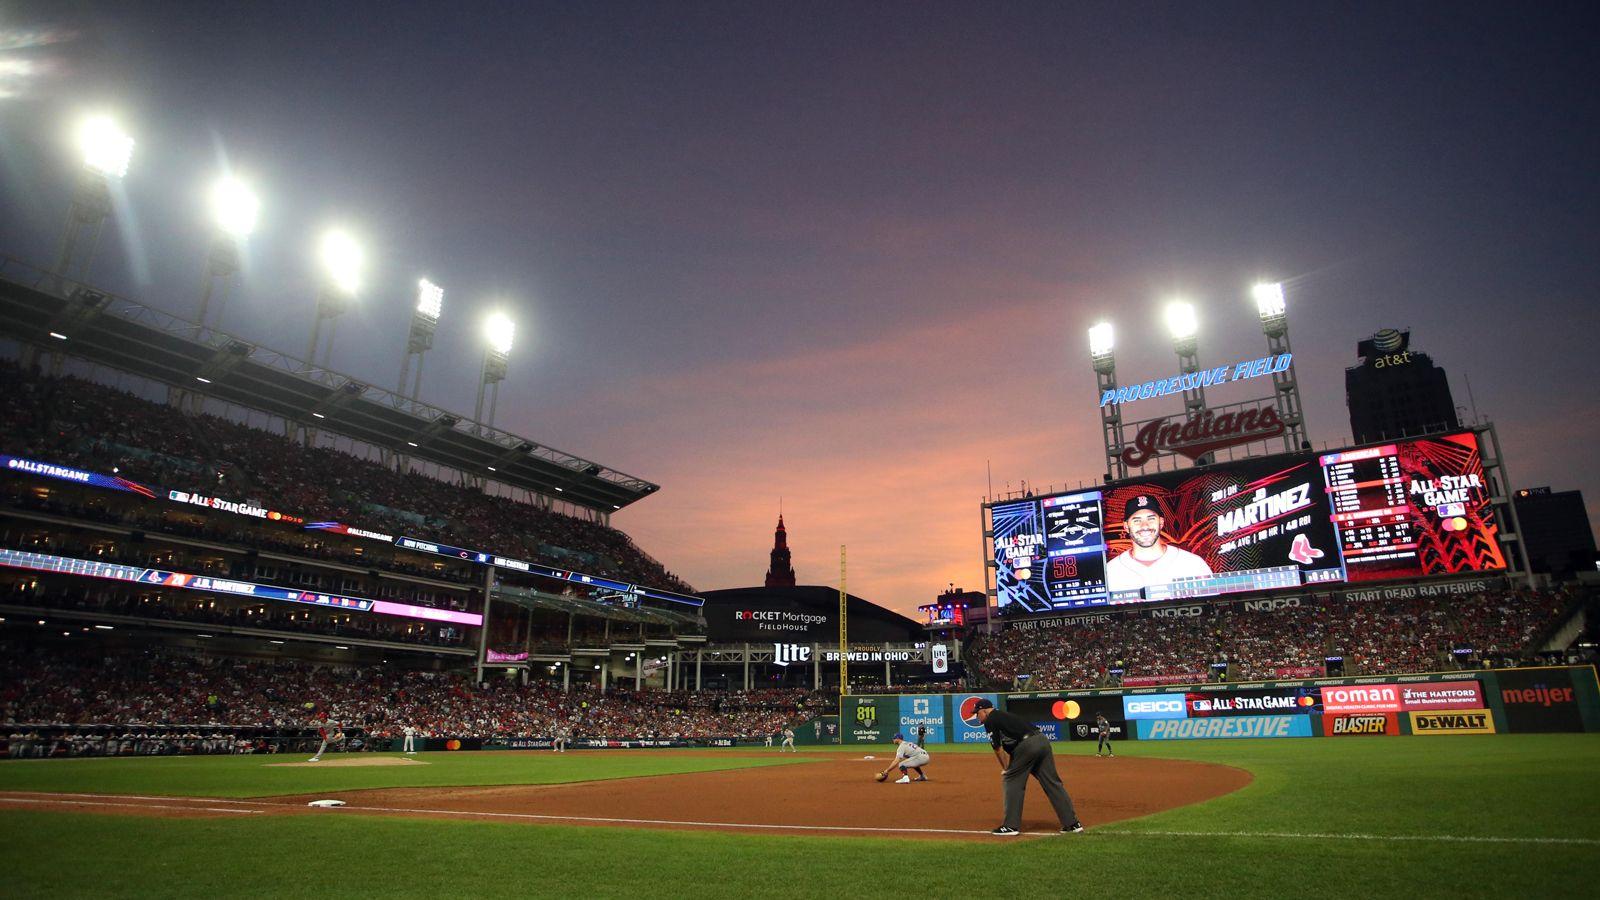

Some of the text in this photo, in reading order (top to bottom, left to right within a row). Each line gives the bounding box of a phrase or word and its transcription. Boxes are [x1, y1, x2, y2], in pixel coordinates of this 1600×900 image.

[1374, 350, 1411, 369] at&t
[1100, 353, 1292, 407] PROGRESSIVE FIELD
[1121, 405, 1285, 468] Indians
[1410, 474, 1482, 495] ALL STAR
[1424, 488, 1470, 506] GAME
[189, 493, 268, 519] ALL STAR GAME
[1217, 482, 1311, 537] MARTINEZ
[1268, 526, 1278, 536] HR
[1299, 515, 1311, 527] RBI
[996, 534, 1045, 549] ALL STAR
[1006, 546, 1035, 559] GAME
[1053, 556, 1078, 578] 58
[1345, 589, 1382, 602] START
[1385, 587, 1417, 600] DEAD
[1152, 607, 1202, 618] NOCO
[1245, 598, 1300, 612] NOCO
[735, 611, 827, 624] ROCKET Mortgage
[1012, 620, 1037, 631] START
[773, 643, 810, 666] Lite
[826, 652, 909, 661] BREWED IN OHIO
[1326, 688, 1395, 703] roman
[1429, 689, 1476, 698] HARTFORD
[1502, 684, 1573, 707] meijer
[1127, 700, 1183, 713] GEICO
[1212, 696, 1297, 710] ALL STAR GAME
[856, 707, 876, 720] 811
[900, 717, 943, 725] Cleveland
[909, 727, 935, 736] Clic
[1090, 726, 1121, 734] RM
[1150, 716, 1292, 738] PROGRESSIVE
[1333, 716, 1386, 734] BLASTER
